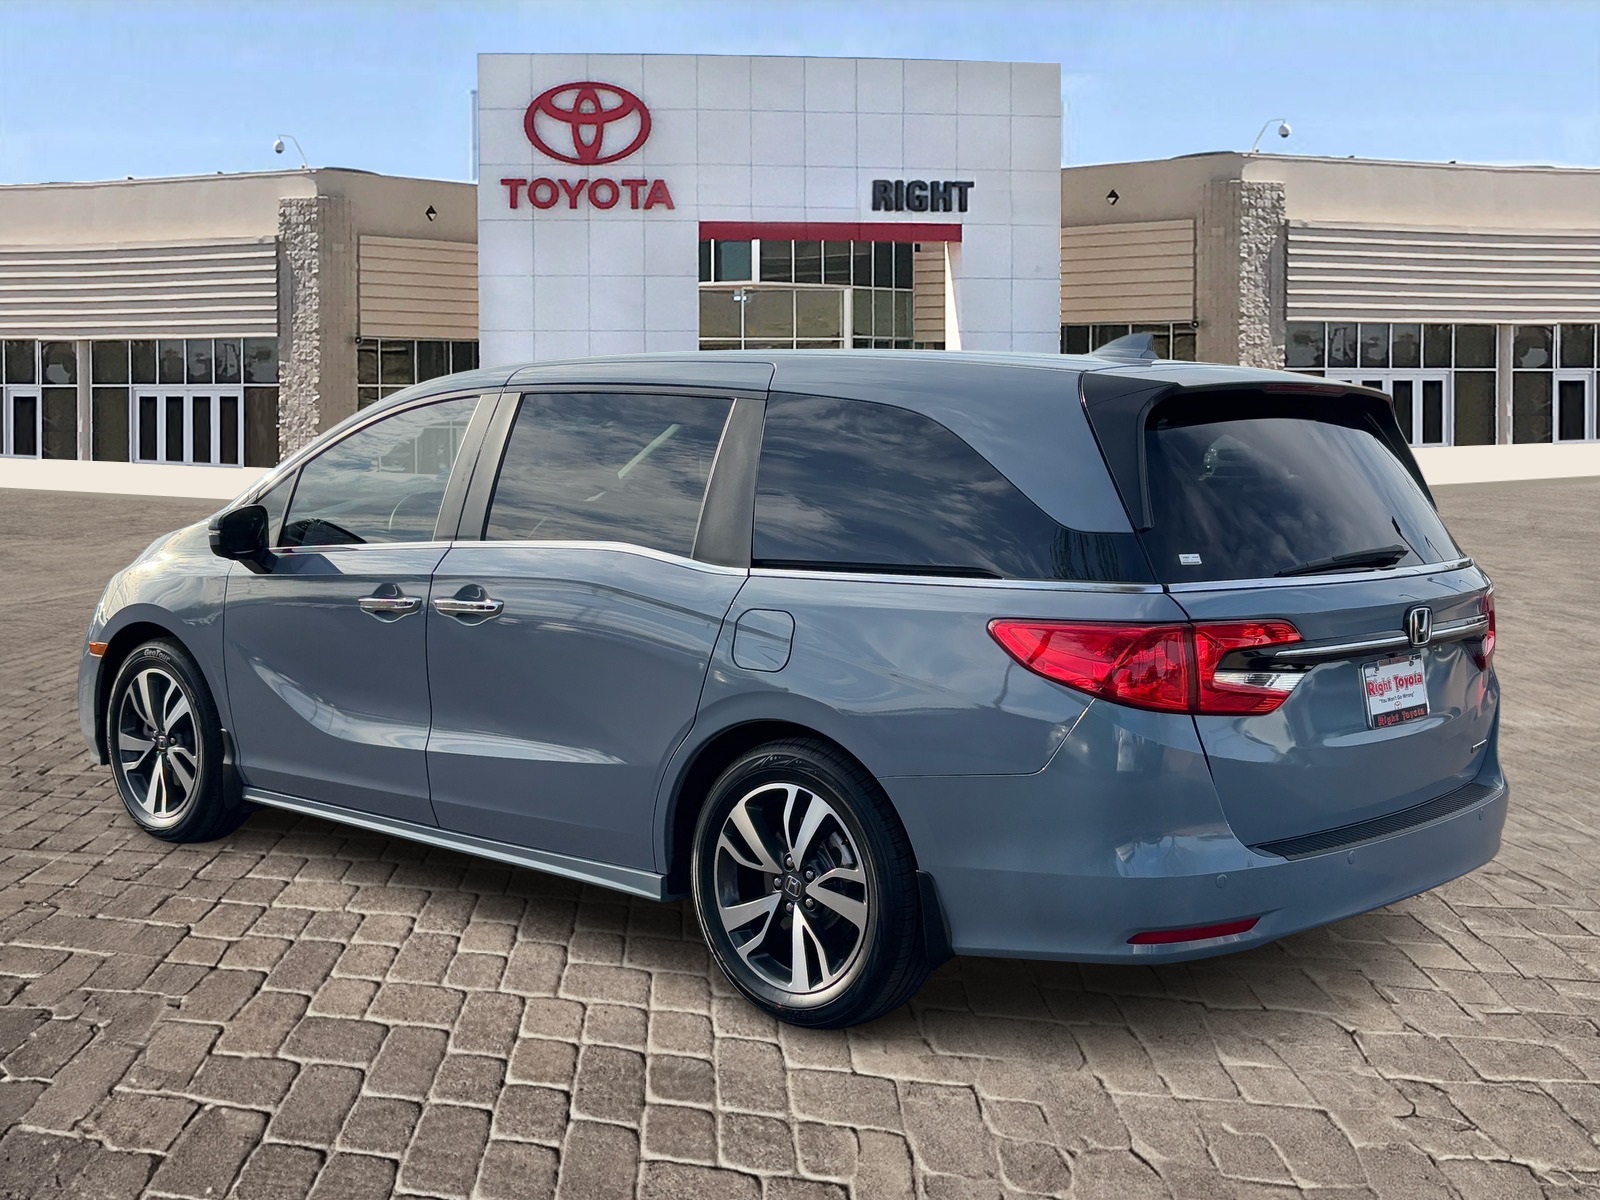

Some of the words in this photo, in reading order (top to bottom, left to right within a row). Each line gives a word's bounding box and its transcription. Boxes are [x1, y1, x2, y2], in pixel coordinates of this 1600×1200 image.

[500, 178, 675, 210] TOYOTA
[871, 179, 975, 212] RIGHT
[1367, 678, 1392, 697] Right
[1393, 672, 1423, 692] Toyota
[1378, 714, 1399, 726] Right
[1402, 709, 1425, 720] Toyota
